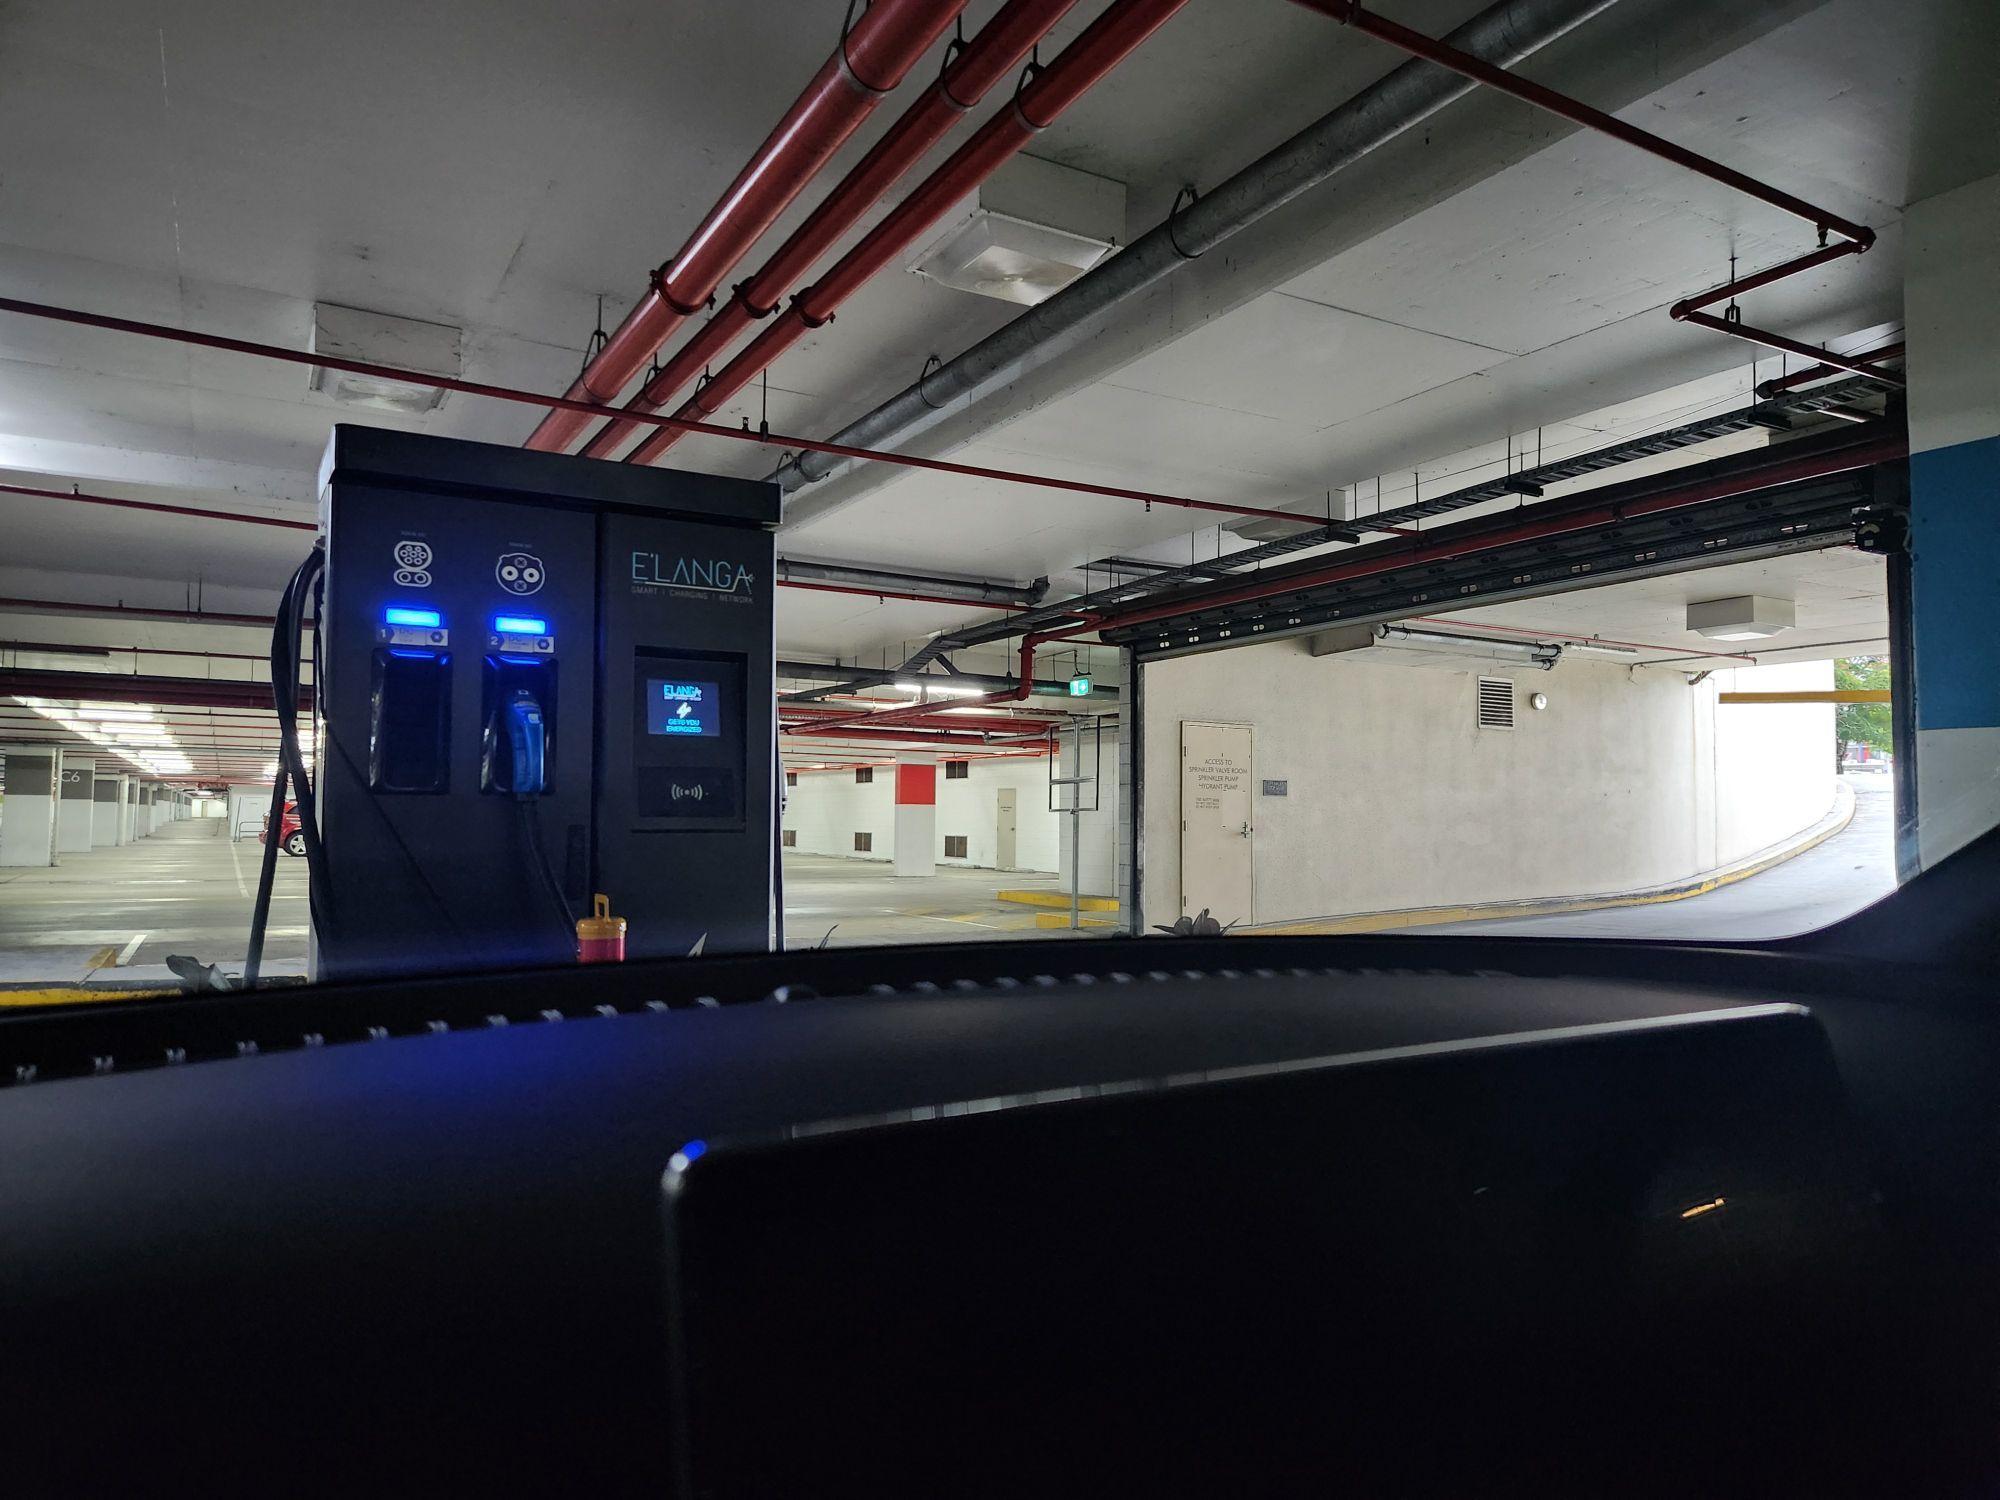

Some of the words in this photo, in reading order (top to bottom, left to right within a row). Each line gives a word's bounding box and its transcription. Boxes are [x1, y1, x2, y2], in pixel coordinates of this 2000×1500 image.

[631, 586, 657, 595] SMART
[669, 589, 708, 600] CHARGING
[719, 594, 753, 604] NETWORK
[381, 629, 387, 638] 1
[490, 636, 498, 646] 2
[61, 770, 81, 783] C6
[1197, 774, 1224, 782] SPRINKLER
